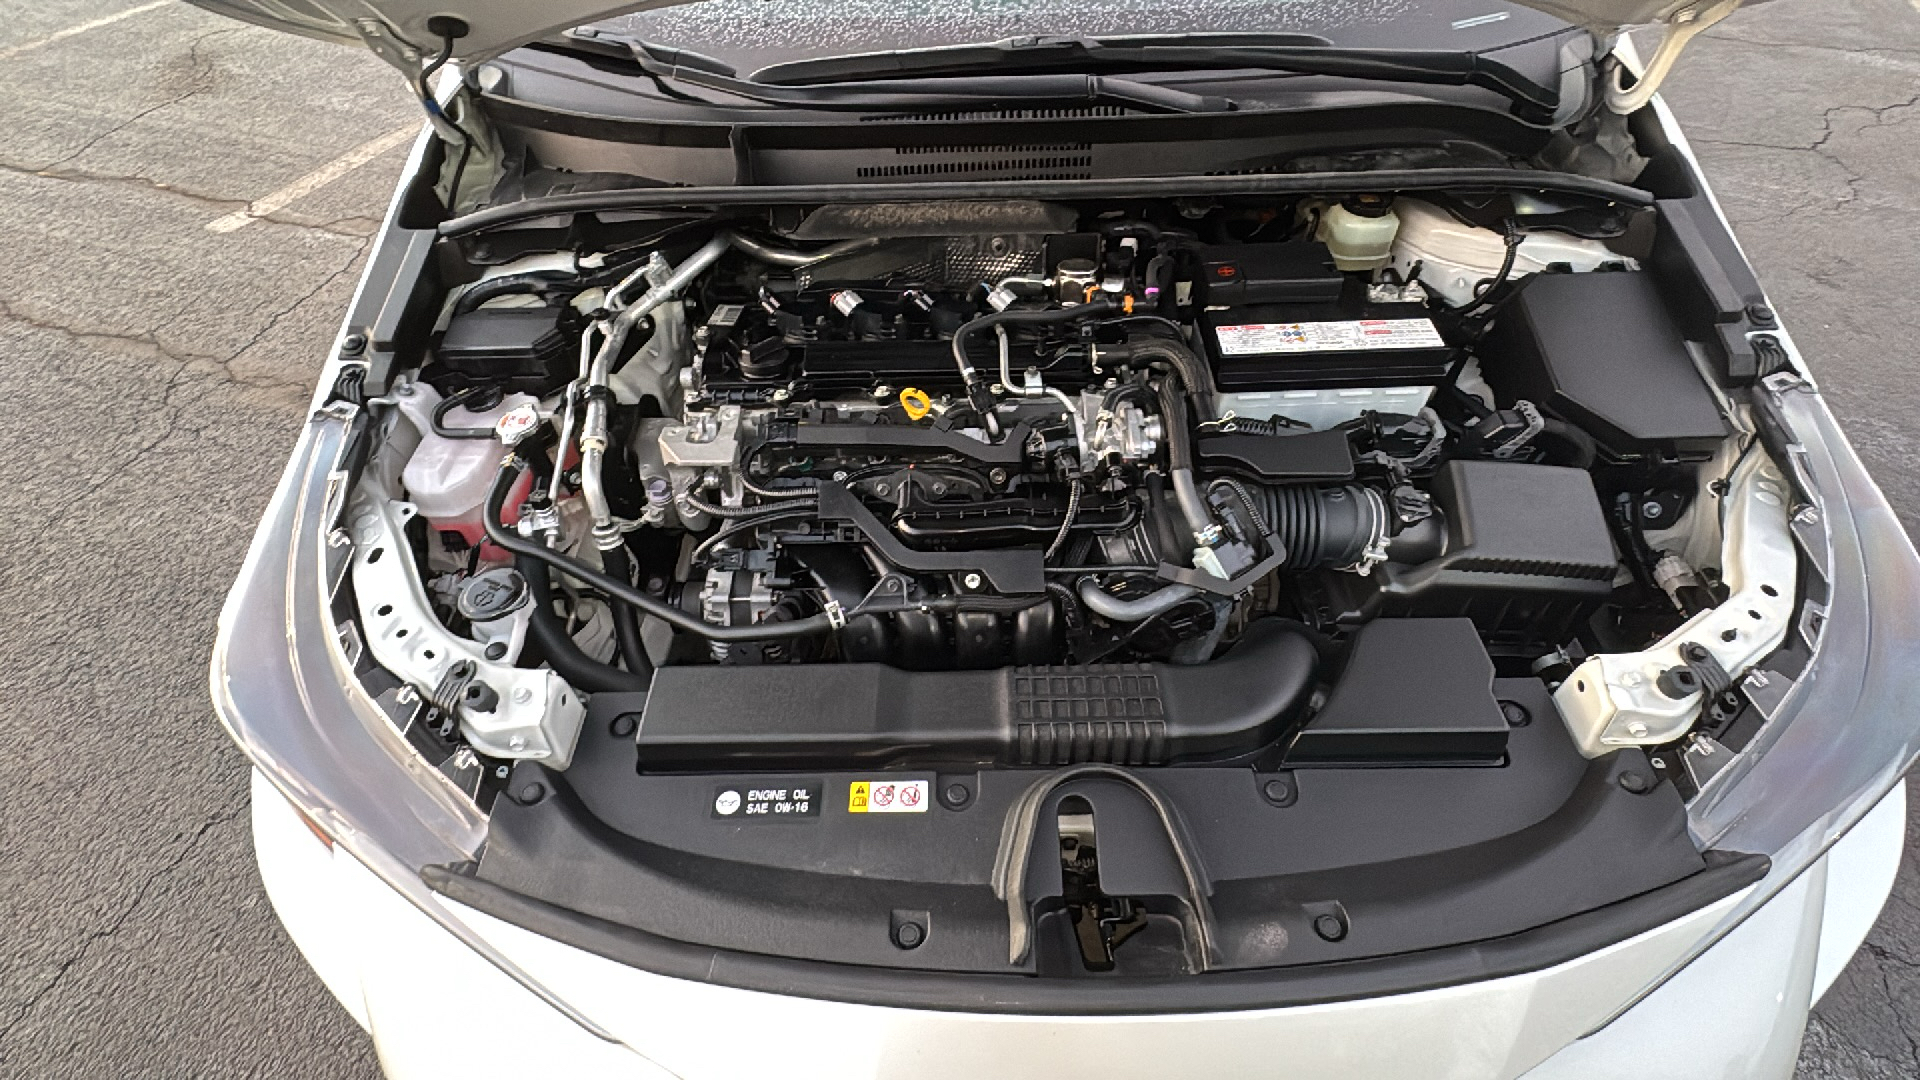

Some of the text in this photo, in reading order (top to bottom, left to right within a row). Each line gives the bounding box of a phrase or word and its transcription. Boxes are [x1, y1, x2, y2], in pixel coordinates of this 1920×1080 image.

[748, 789, 810, 801] ENGINE OIL
[746, 802, 769, 814] SAE
